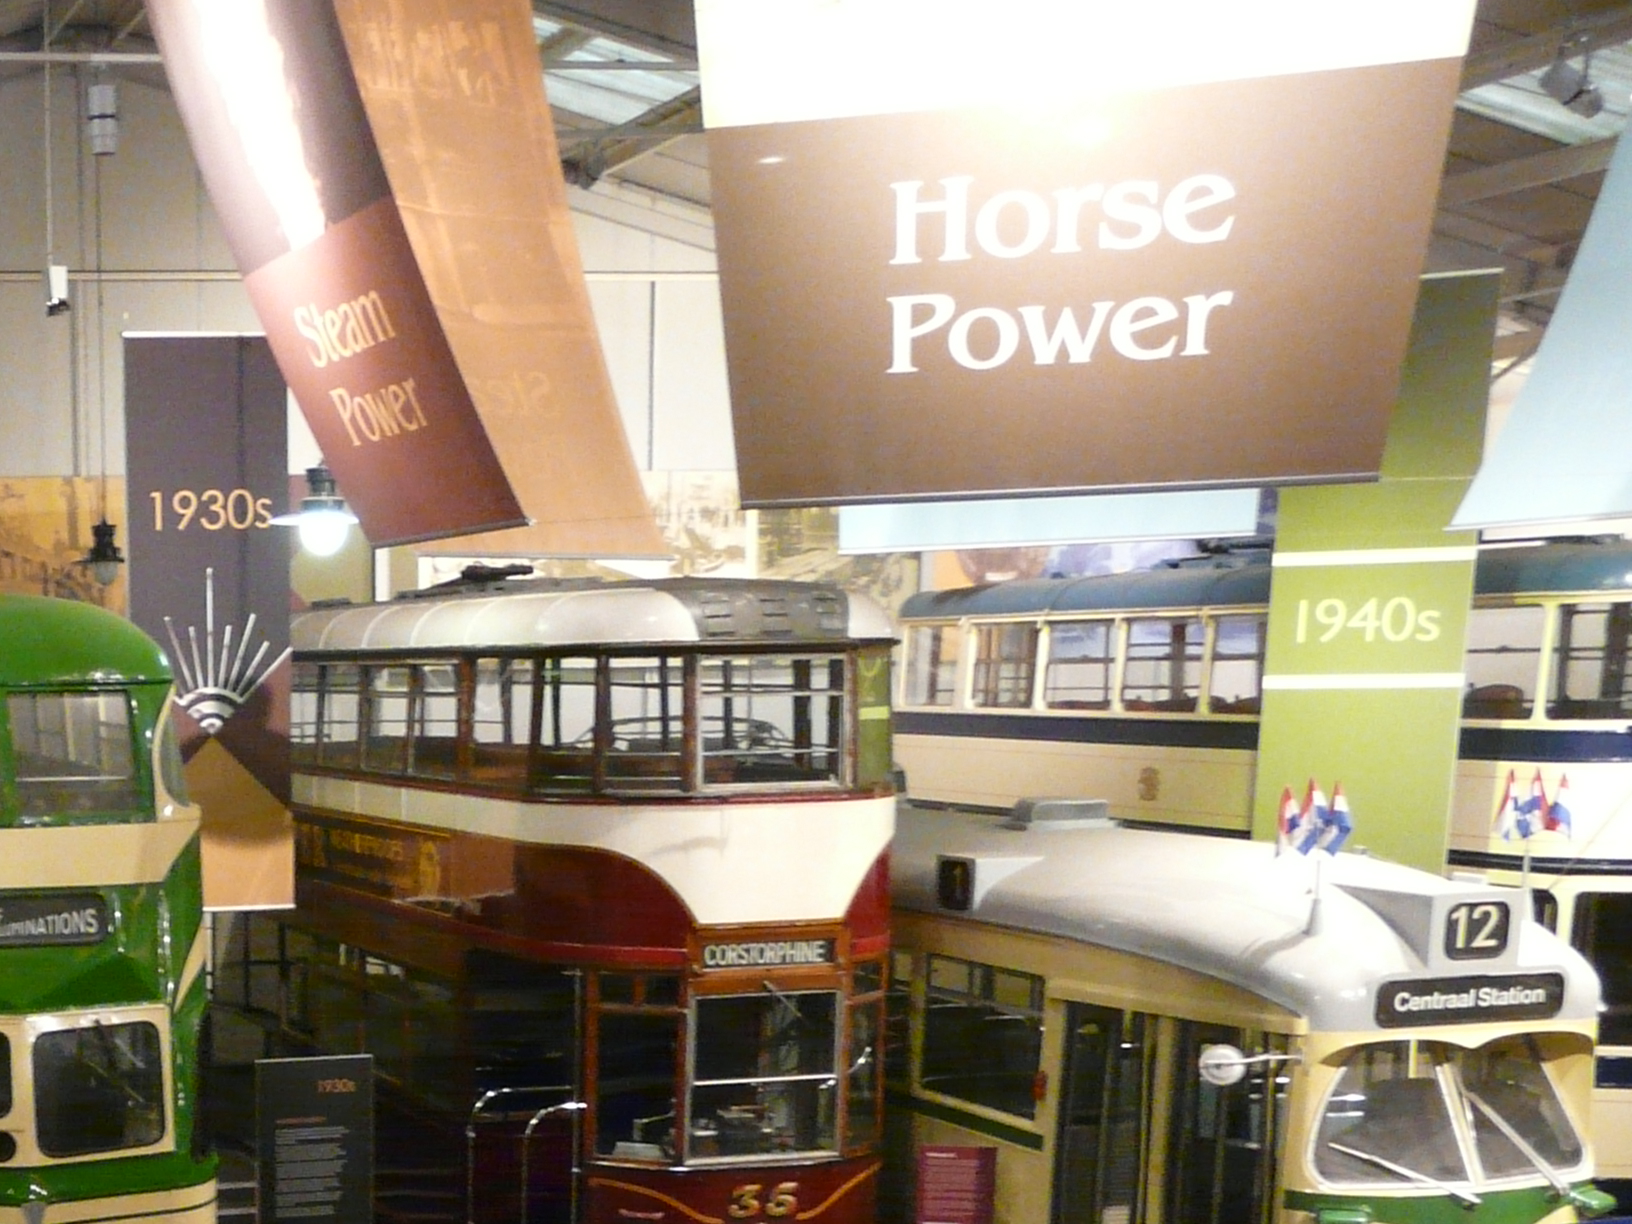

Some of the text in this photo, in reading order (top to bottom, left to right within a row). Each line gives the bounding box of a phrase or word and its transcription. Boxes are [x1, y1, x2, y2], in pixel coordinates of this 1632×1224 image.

[889, 173, 1236, 264] Horse
[294, 290, 396, 367] Steam
[885, 290, 1234, 373] Power
[329, 377, 428, 446] Power
[150, 489, 272, 531] 1930s
[1296, 596, 1441, 643] 1940s
[1451, 905, 1501, 949] 12
[704, 941, 826, 966] CORSTORPHINE
[1394, 985, 1546, 1012] Centraal Station
[729, 1182, 798, 1217] 35
